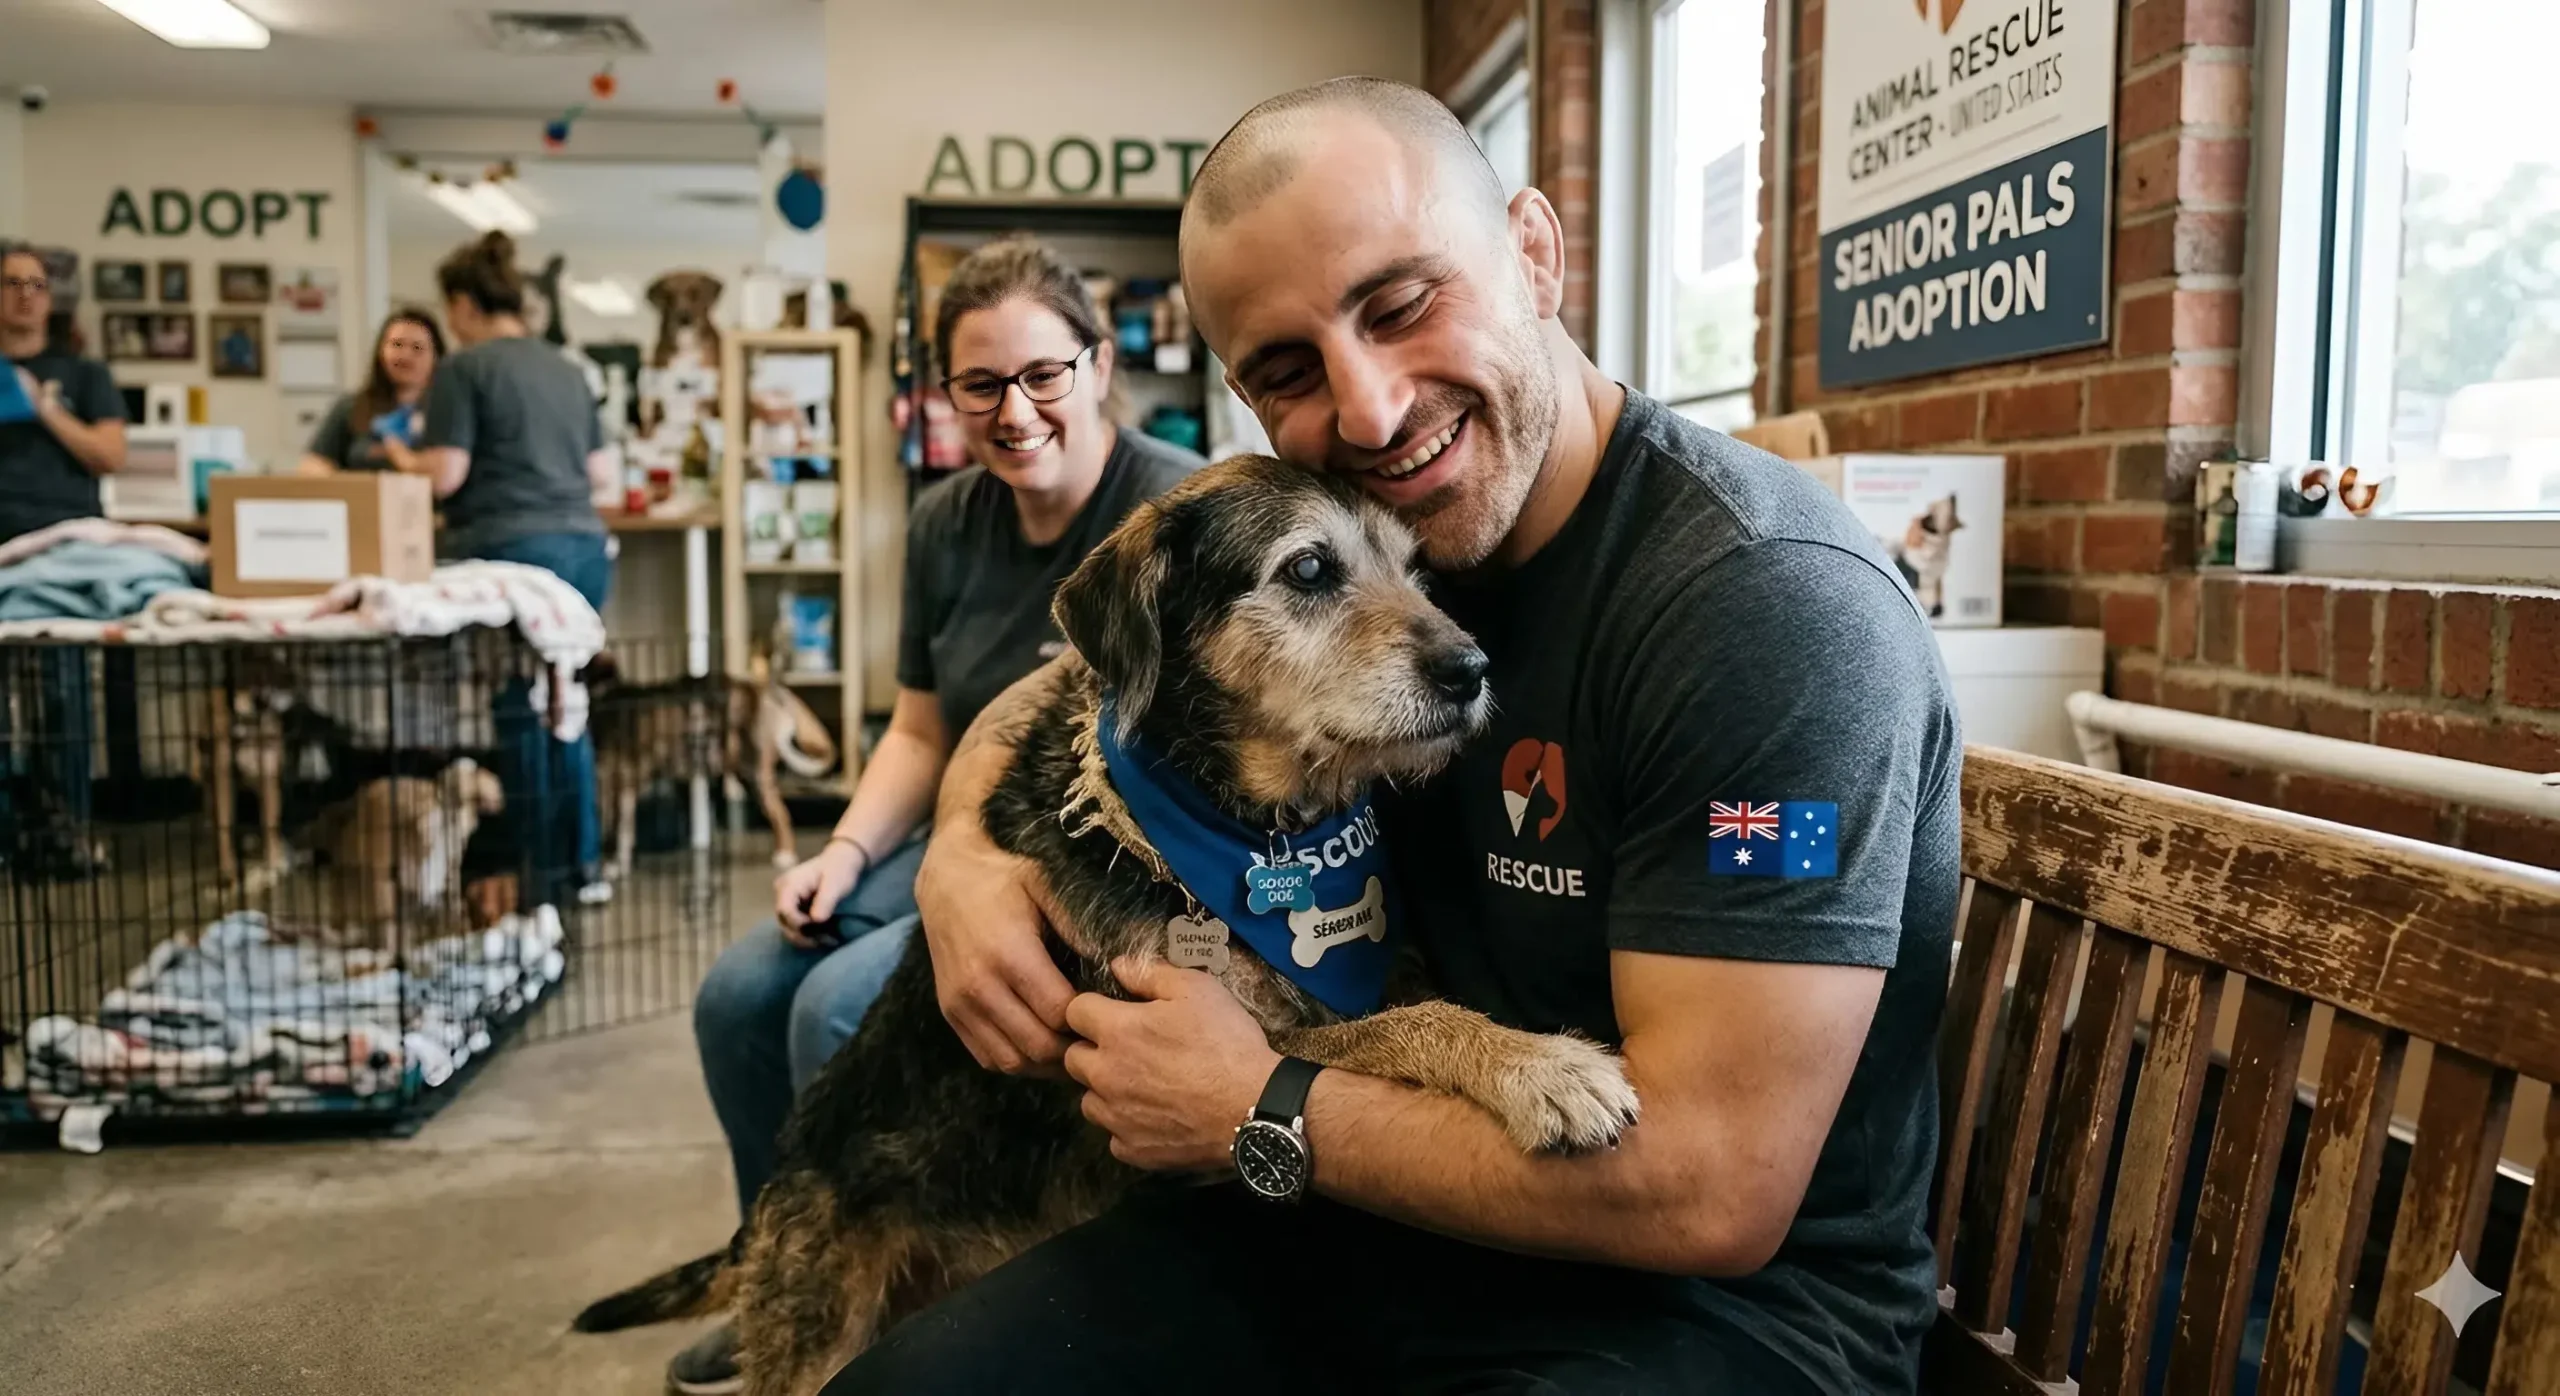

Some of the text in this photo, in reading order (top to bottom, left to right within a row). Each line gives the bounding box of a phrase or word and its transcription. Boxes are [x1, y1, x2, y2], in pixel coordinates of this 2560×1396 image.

[1848, 0, 2065, 136] ANIMAL RESCUE
[1848, 52, 2064, 182] CENTER UNITED STATES
[100, 186, 332, 240] ADOPT
[926, 134, 1209, 197] ADOPT
[1833, 160, 2076, 291] SENIOR PALS
[1848, 249, 2048, 353] ADOPTION
[1487, 852, 1586, 897] RESCUE
